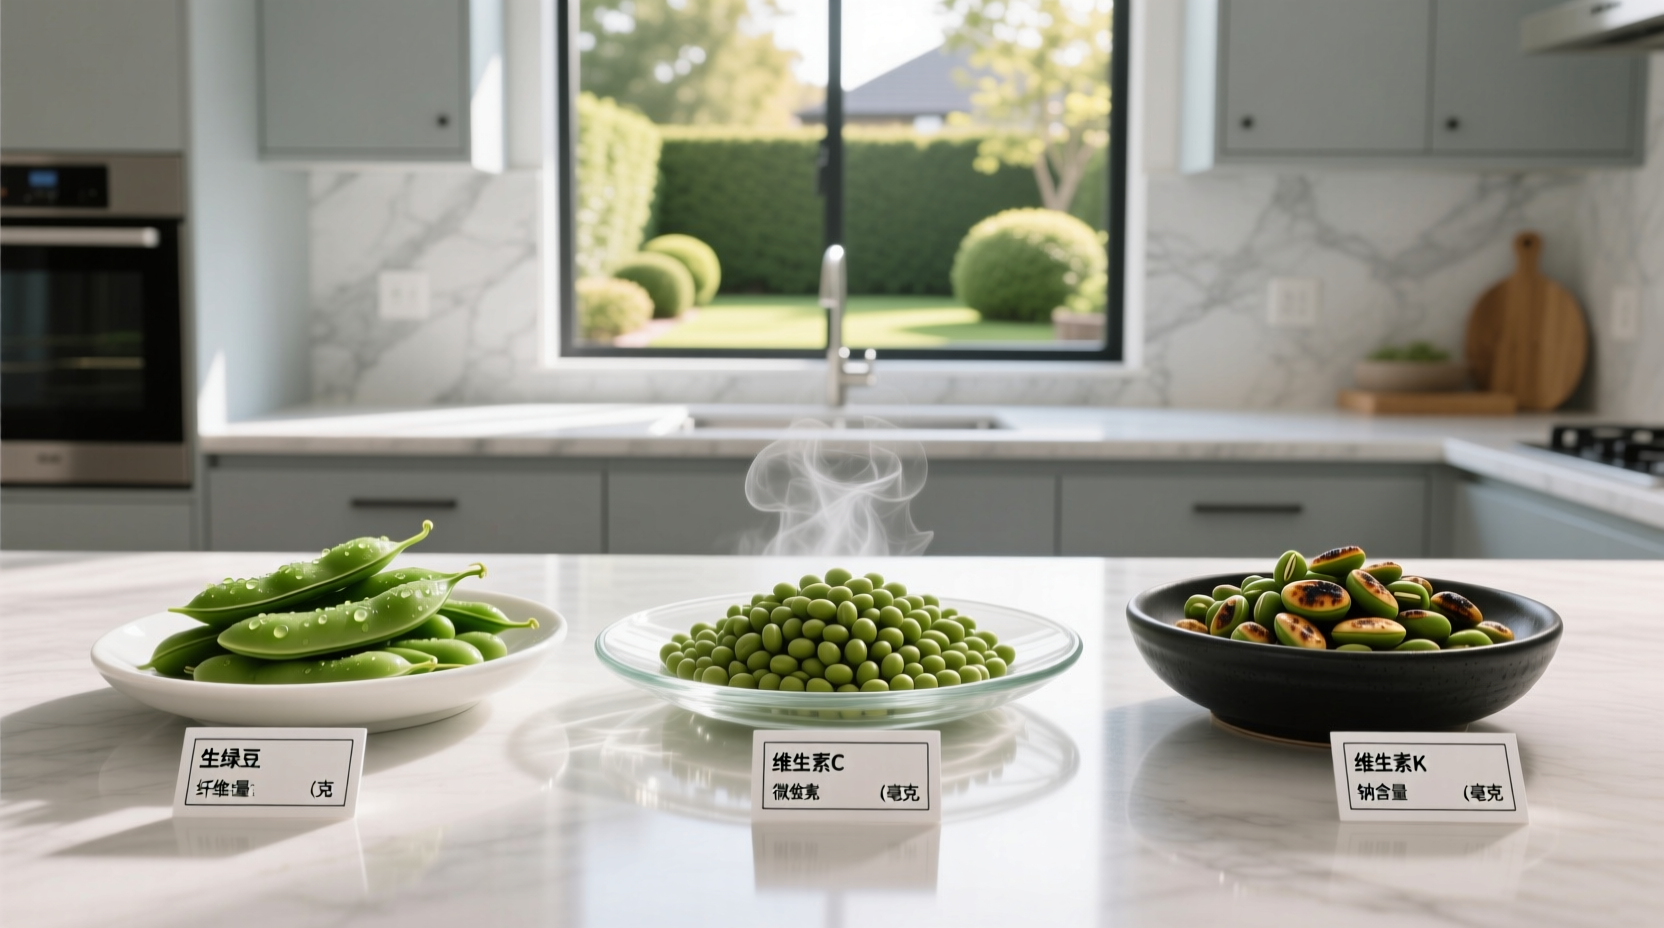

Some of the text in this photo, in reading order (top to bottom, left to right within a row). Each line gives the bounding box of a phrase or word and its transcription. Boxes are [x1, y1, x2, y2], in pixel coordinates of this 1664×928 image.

[199, 748, 260, 769] 生绿豆
[772, 752, 845, 773] 维生素C
[1354, 752, 1427, 773] 维生素K
[1357, 783, 1408, 801] 钠含量
